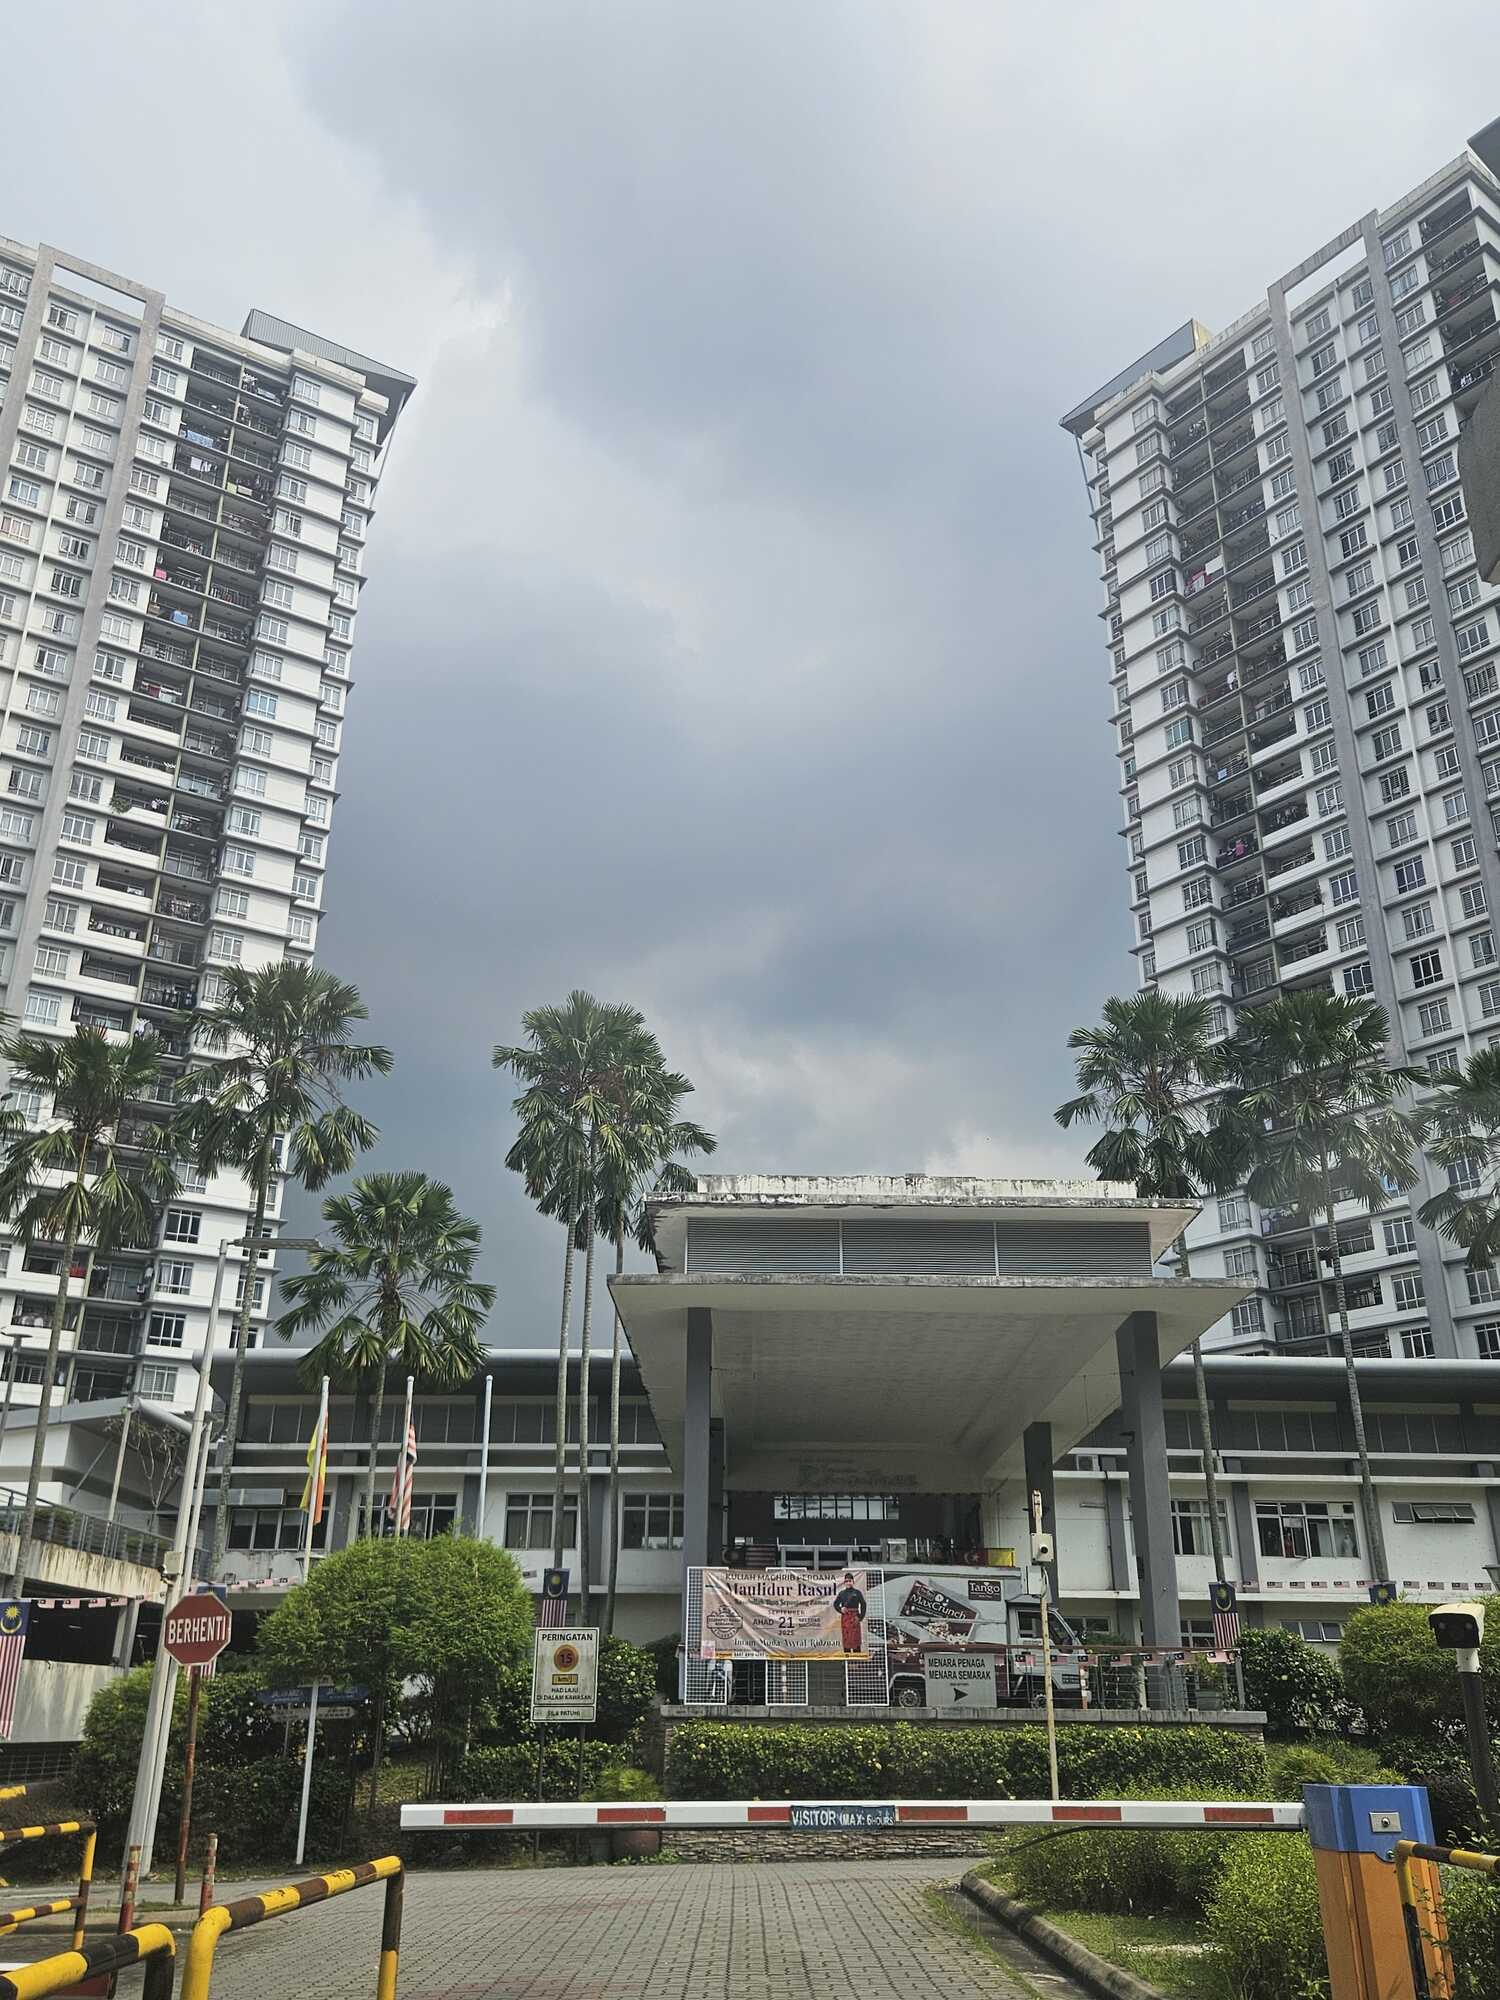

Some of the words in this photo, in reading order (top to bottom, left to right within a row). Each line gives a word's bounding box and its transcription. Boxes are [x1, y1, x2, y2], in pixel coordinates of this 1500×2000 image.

[726, 1582, 793, 1596] Maulidur
[797, 1582, 837, 1596] Rasul
[968, 1582, 1001, 1595] Tango
[911, 1593, 967, 1620] MaxCrunch
[778, 1616, 795, 1628] 21
[168, 1615, 226, 1644] BERHENTI
[542, 1633, 593, 1641] PERINGATAN
[560, 1652, 573, 1664] 15
[928, 1657, 956, 1668] MENARA
[957, 1657, 986, 1668] PENAGA
[928, 1670, 957, 1680] MENARA
[958, 1670, 991, 1681] SEMARAK
[791, 1809, 837, 1826] VISITOR
